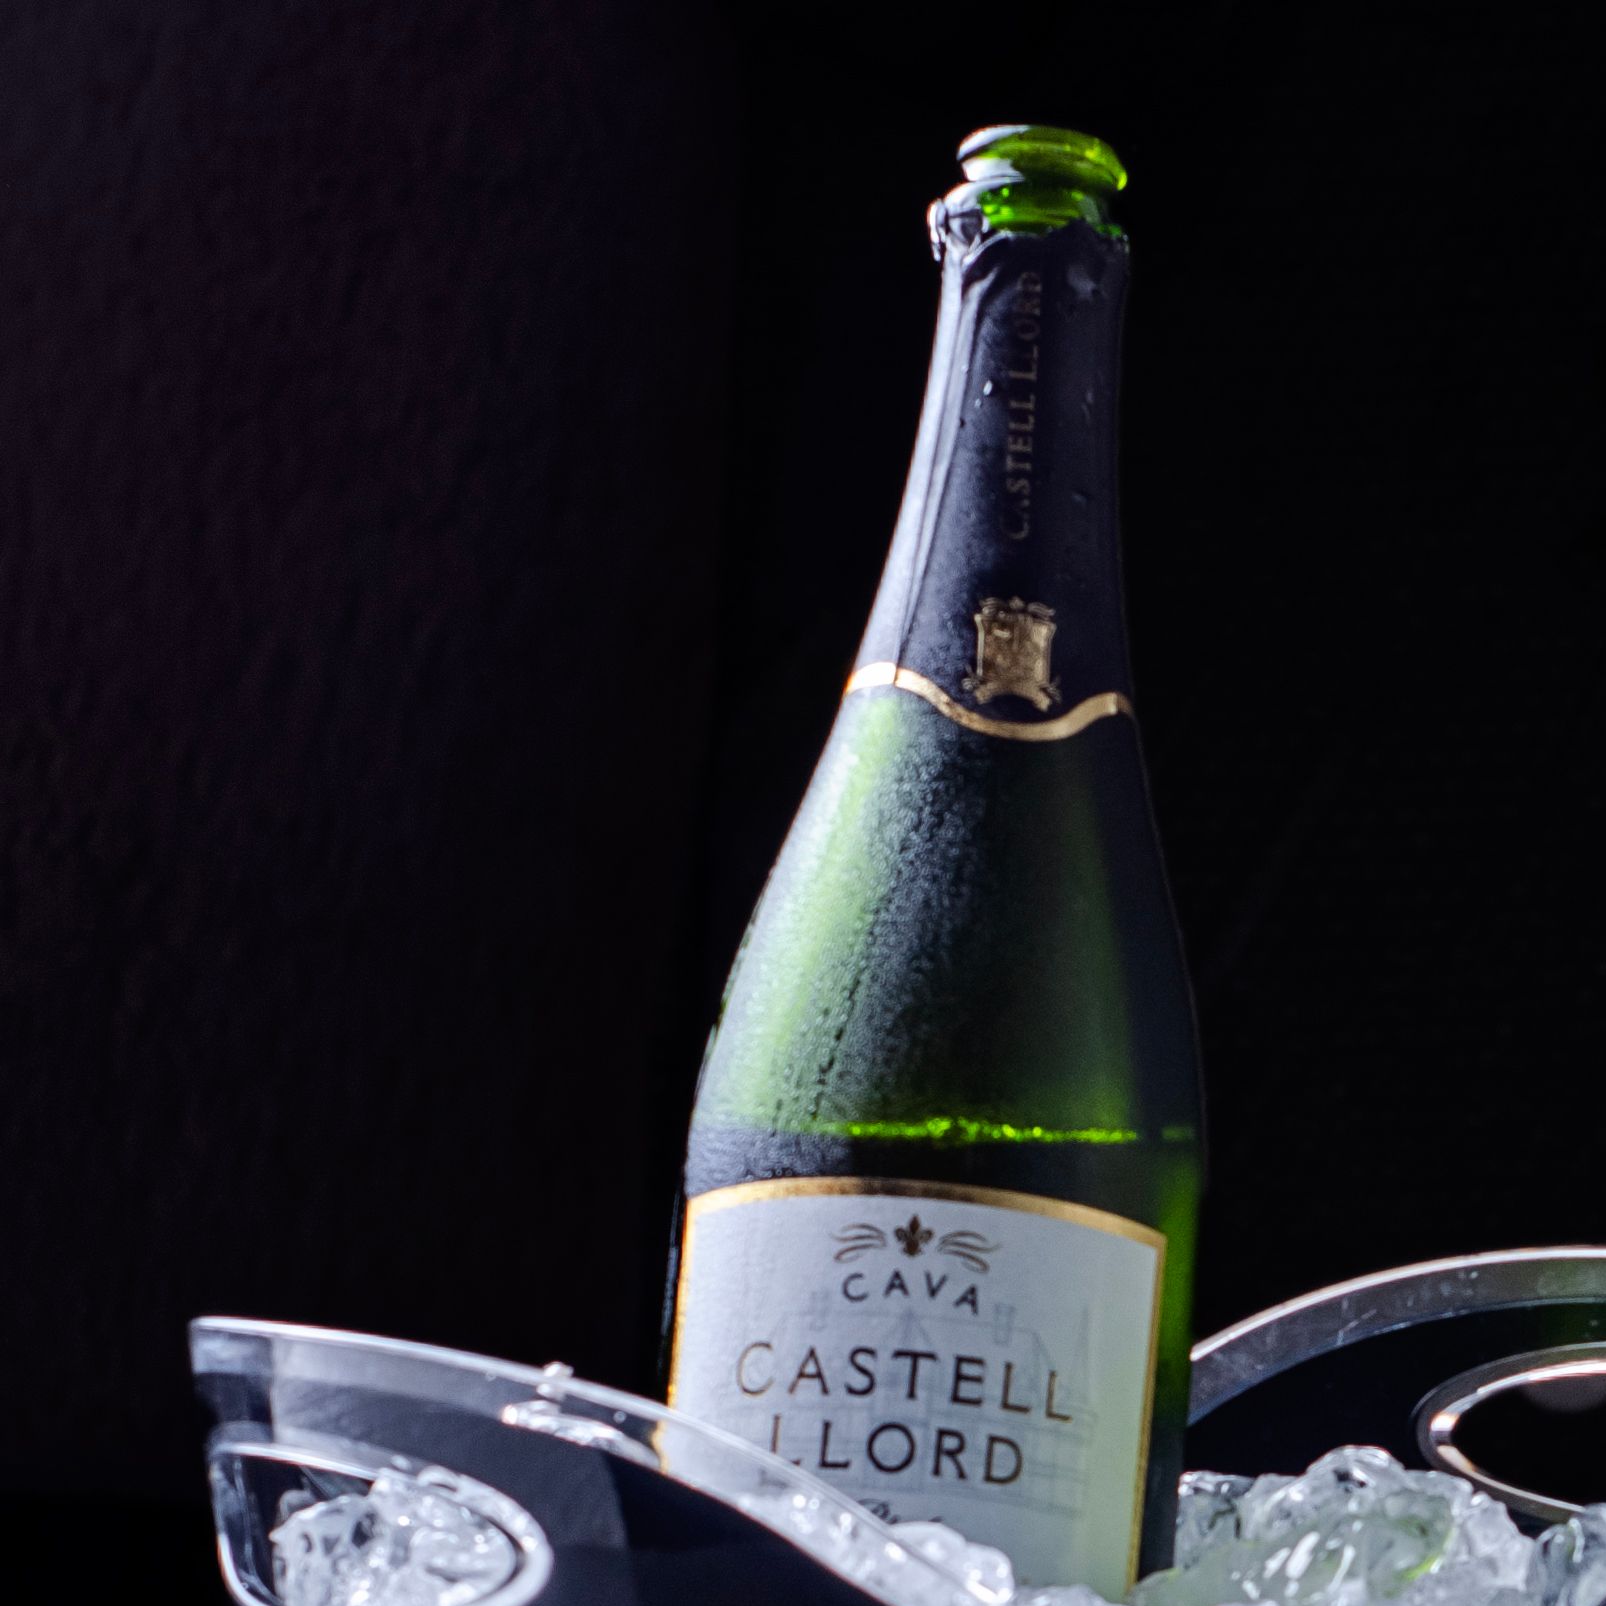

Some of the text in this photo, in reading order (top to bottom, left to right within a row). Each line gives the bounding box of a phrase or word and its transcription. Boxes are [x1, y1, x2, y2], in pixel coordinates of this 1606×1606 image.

[843, 1270, 980, 1316] CAVA
[737, 1342, 1073, 1421] CASTELL
[770, 1414, 1024, 1485] LLORD
